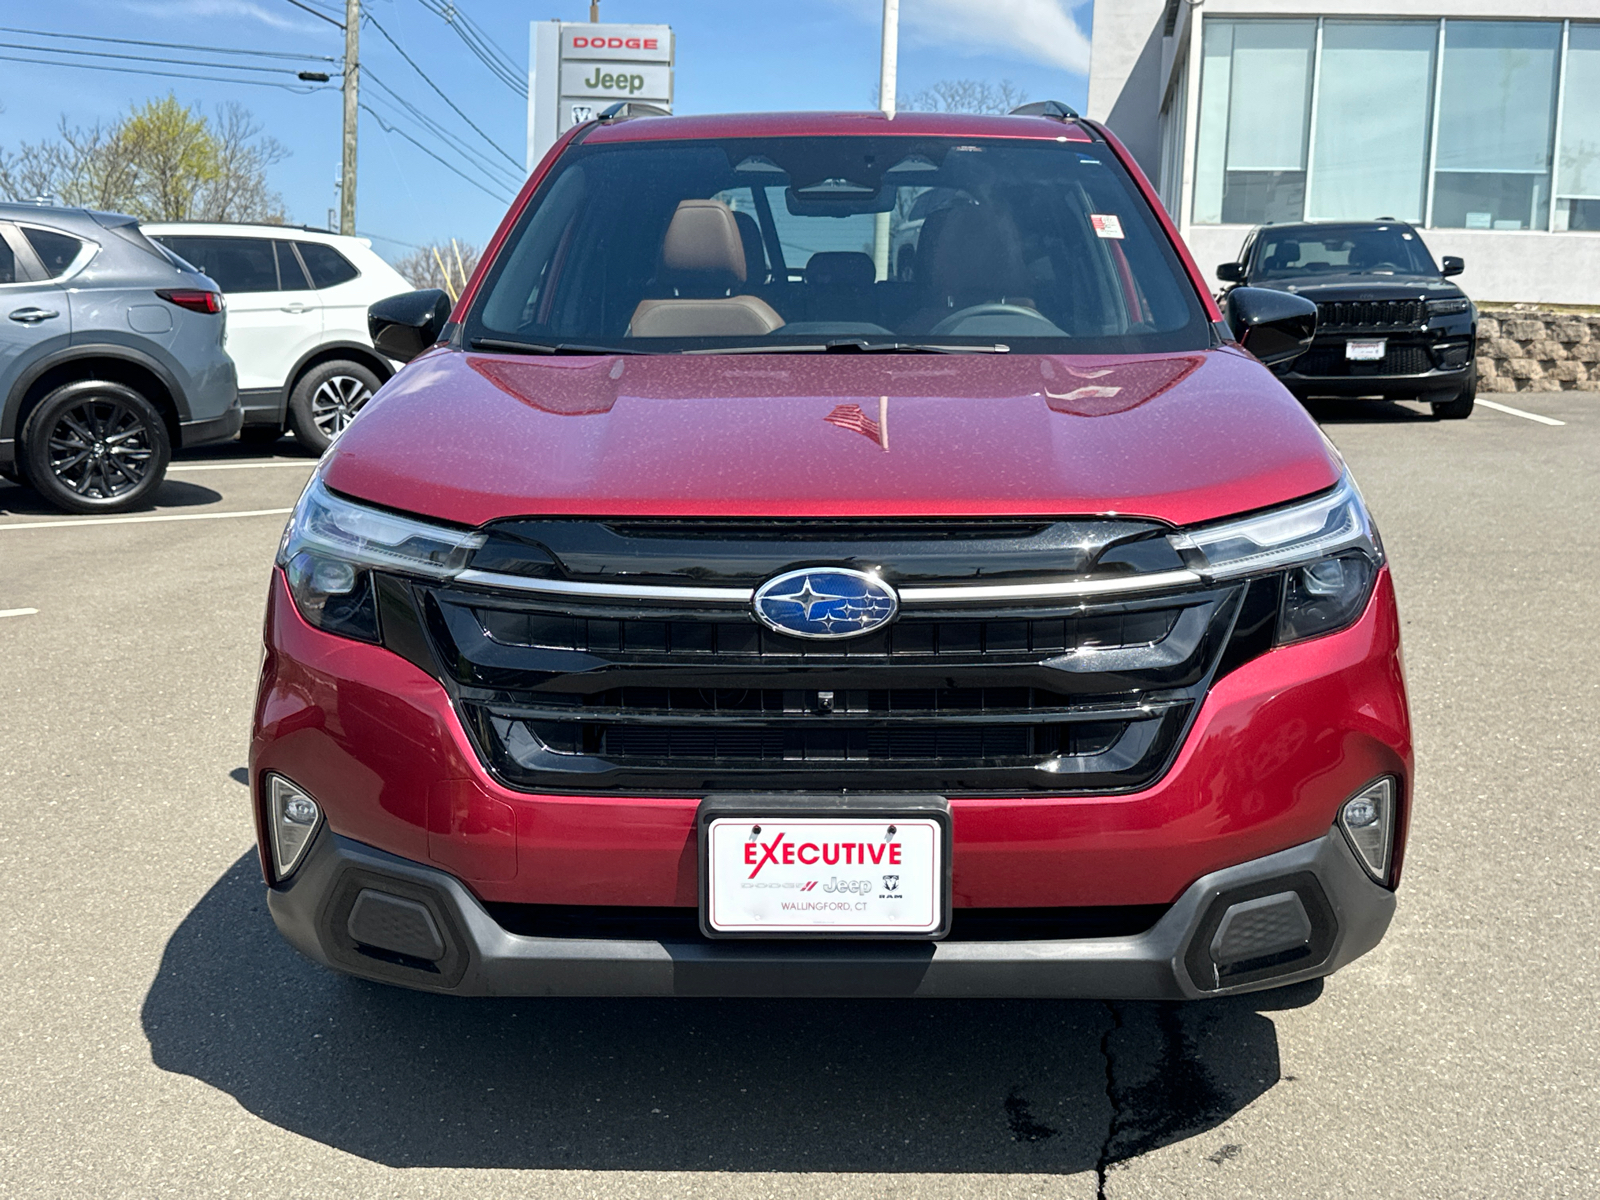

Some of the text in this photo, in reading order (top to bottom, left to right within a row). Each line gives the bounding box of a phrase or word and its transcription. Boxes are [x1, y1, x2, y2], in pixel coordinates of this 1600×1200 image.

[573, 37, 658, 49] DODGE
[585, 67, 644, 94] Jeep
[744, 832, 902, 879] EXECUTIVE
[823, 877, 872, 896] Jeep
[781, 902, 867, 911] WALLINGFORD, CT
